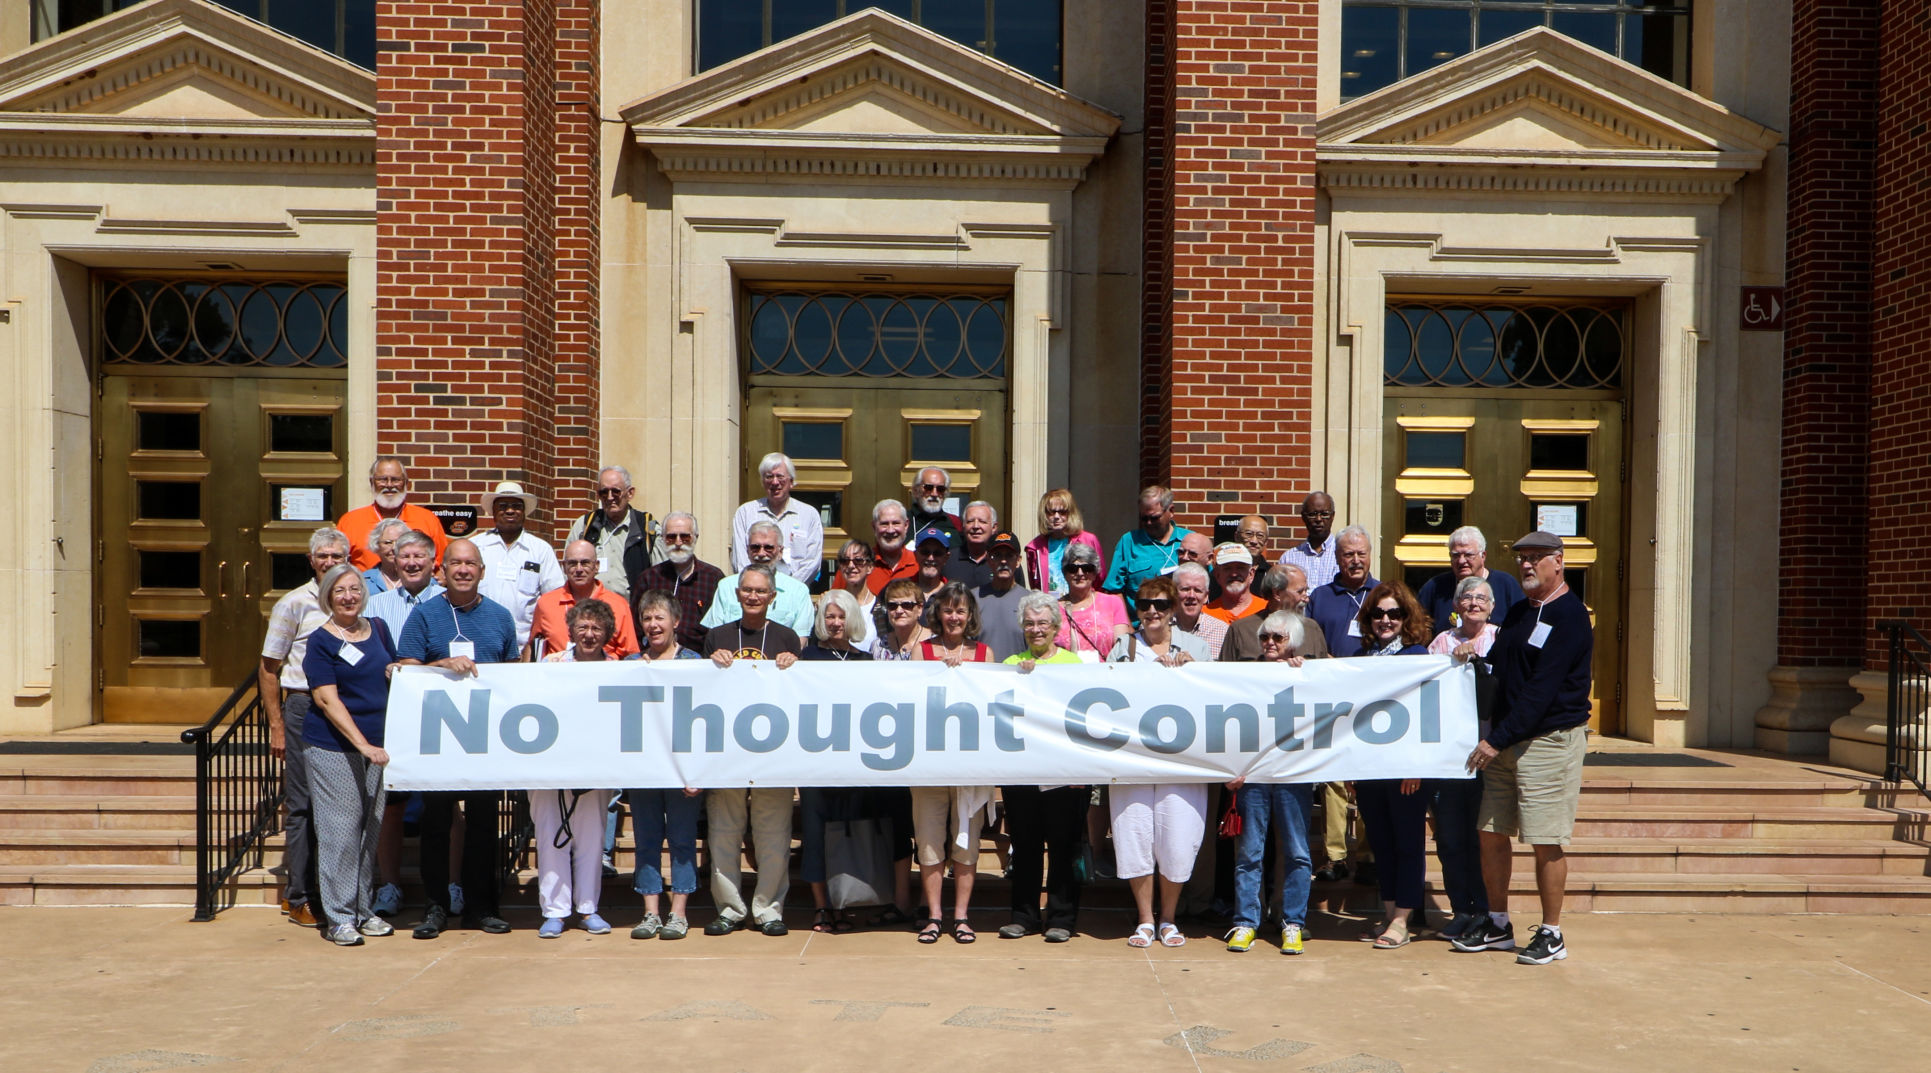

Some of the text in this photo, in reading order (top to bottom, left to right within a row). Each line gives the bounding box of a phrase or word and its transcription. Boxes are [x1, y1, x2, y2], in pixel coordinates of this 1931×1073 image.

[420, 680, 1440, 772] No Thought Control
